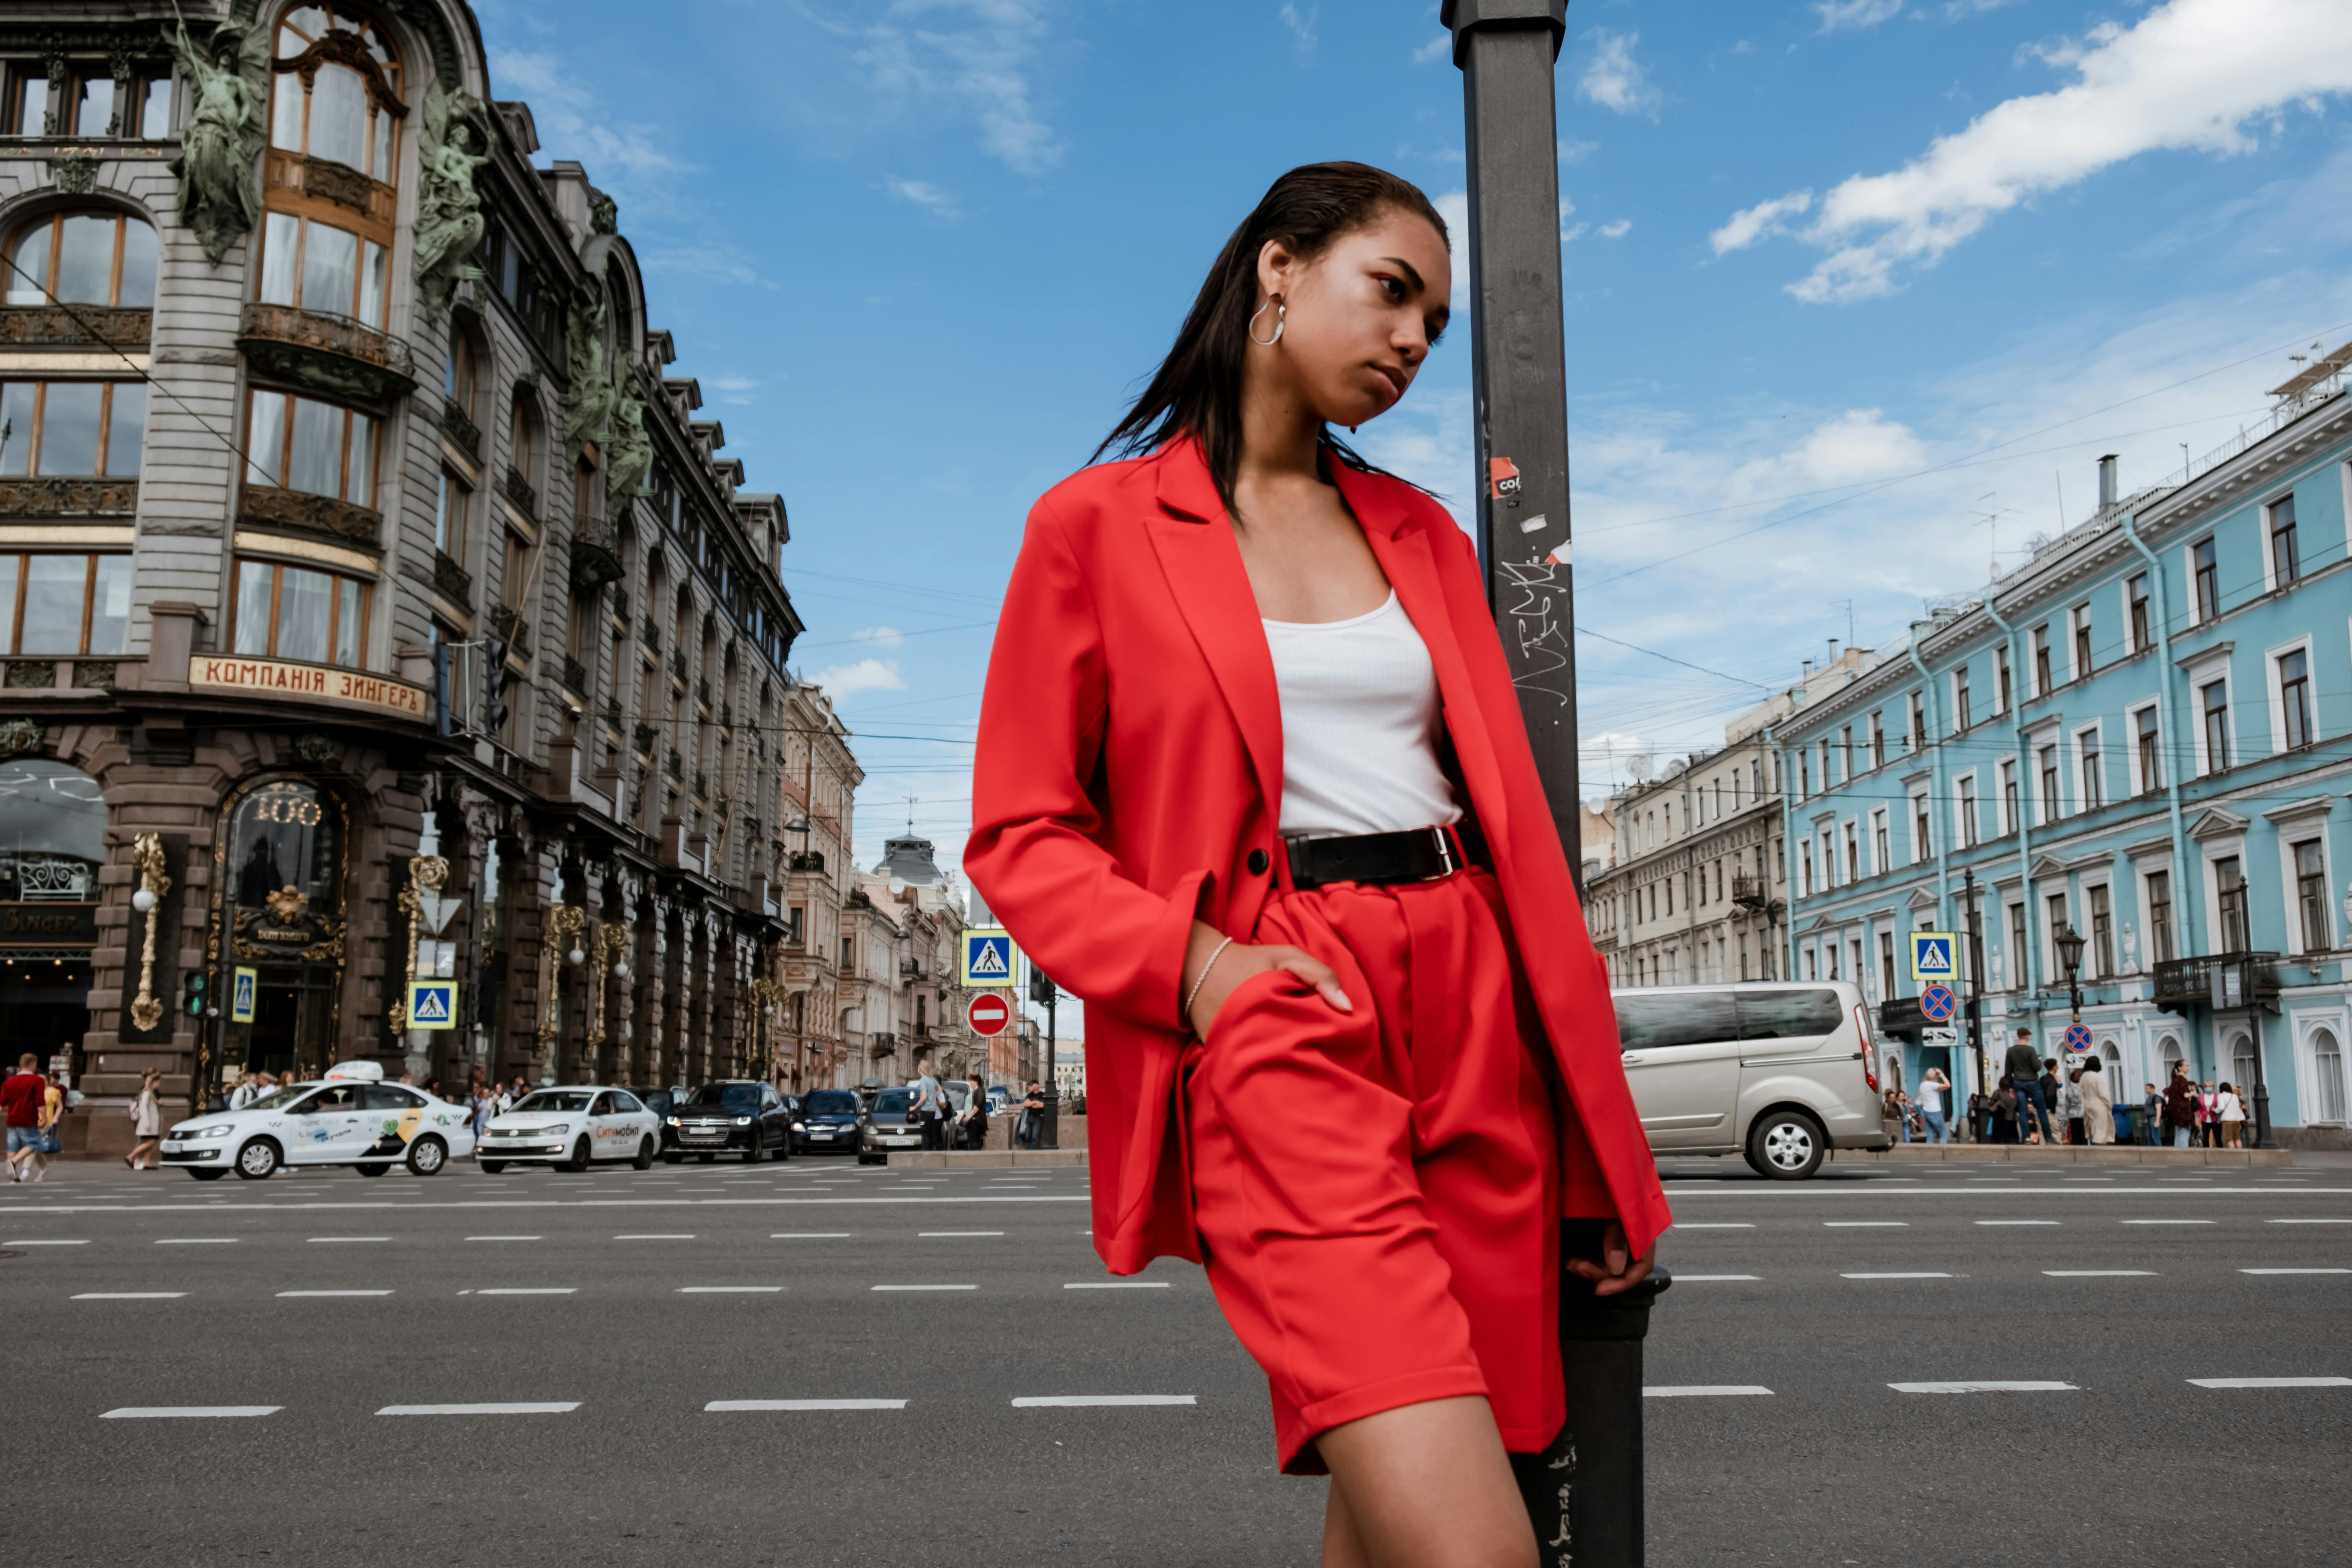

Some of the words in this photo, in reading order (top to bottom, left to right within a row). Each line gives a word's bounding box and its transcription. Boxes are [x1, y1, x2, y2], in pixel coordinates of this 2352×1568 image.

[206, 661, 324, 692] КОМПАНІЯ
[340, 676, 417, 711] ЗИНГЕРЪ
[596, 1123, 638, 1138] Ситимобил
